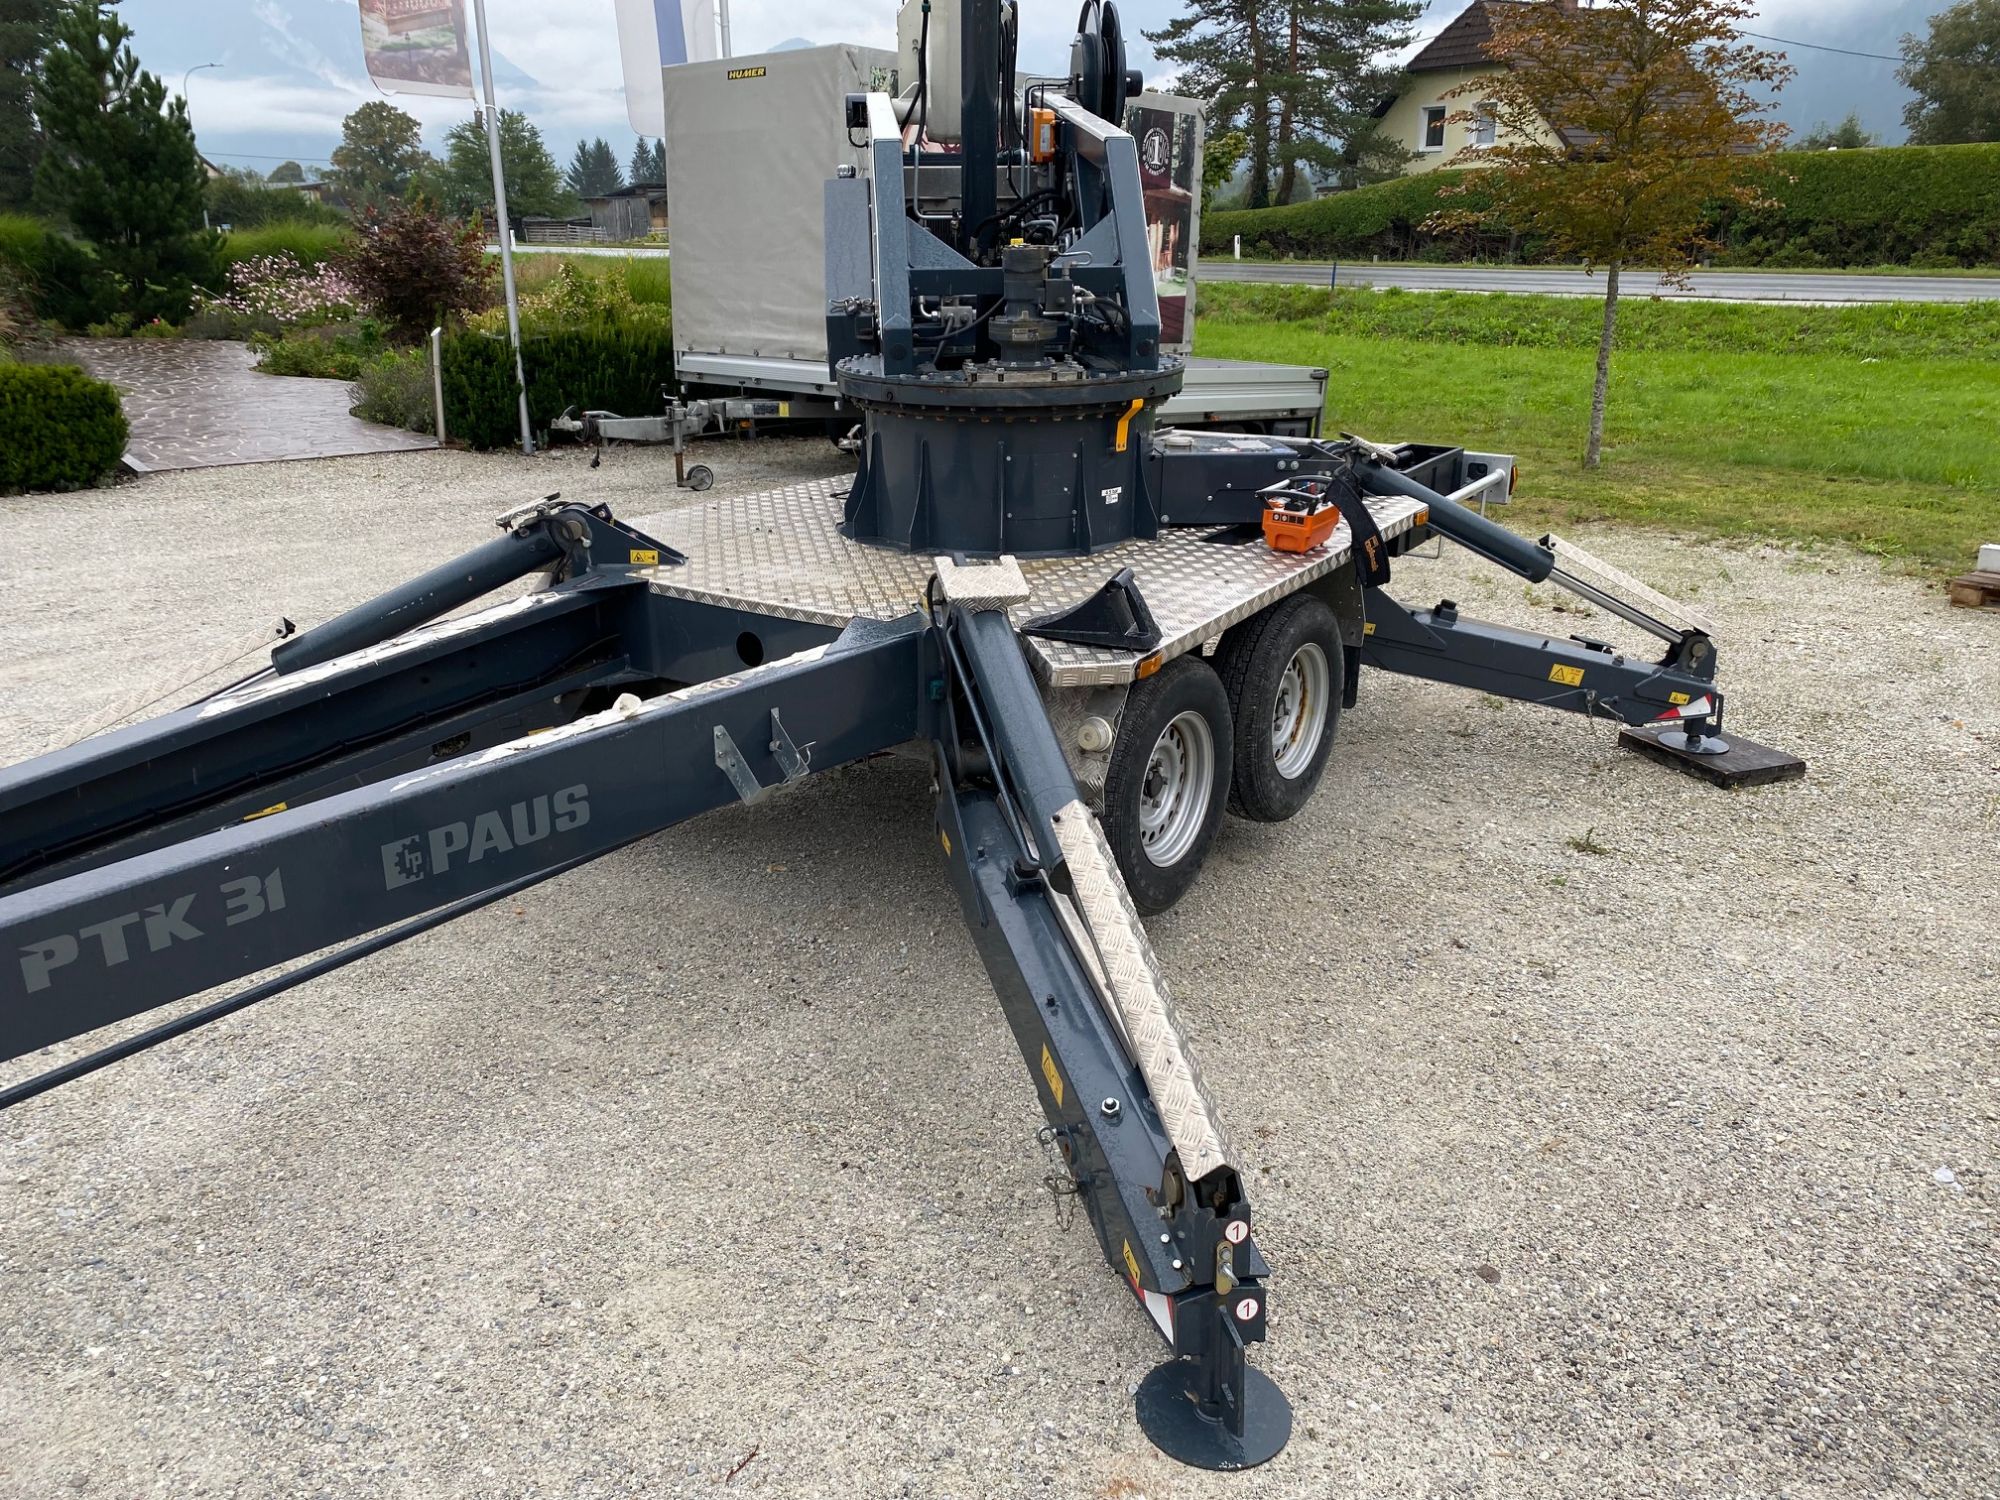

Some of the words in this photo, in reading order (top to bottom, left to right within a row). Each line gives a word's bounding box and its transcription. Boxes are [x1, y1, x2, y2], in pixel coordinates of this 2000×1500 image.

[729, 68, 764, 78] HUMER
[429, 784, 591, 875] PAUS
[18, 893, 204, 993] PTK
[219, 868, 286, 927] 31
[1231, 1223, 1241, 1240] 1
[1242, 1301, 1252, 1317] 1
